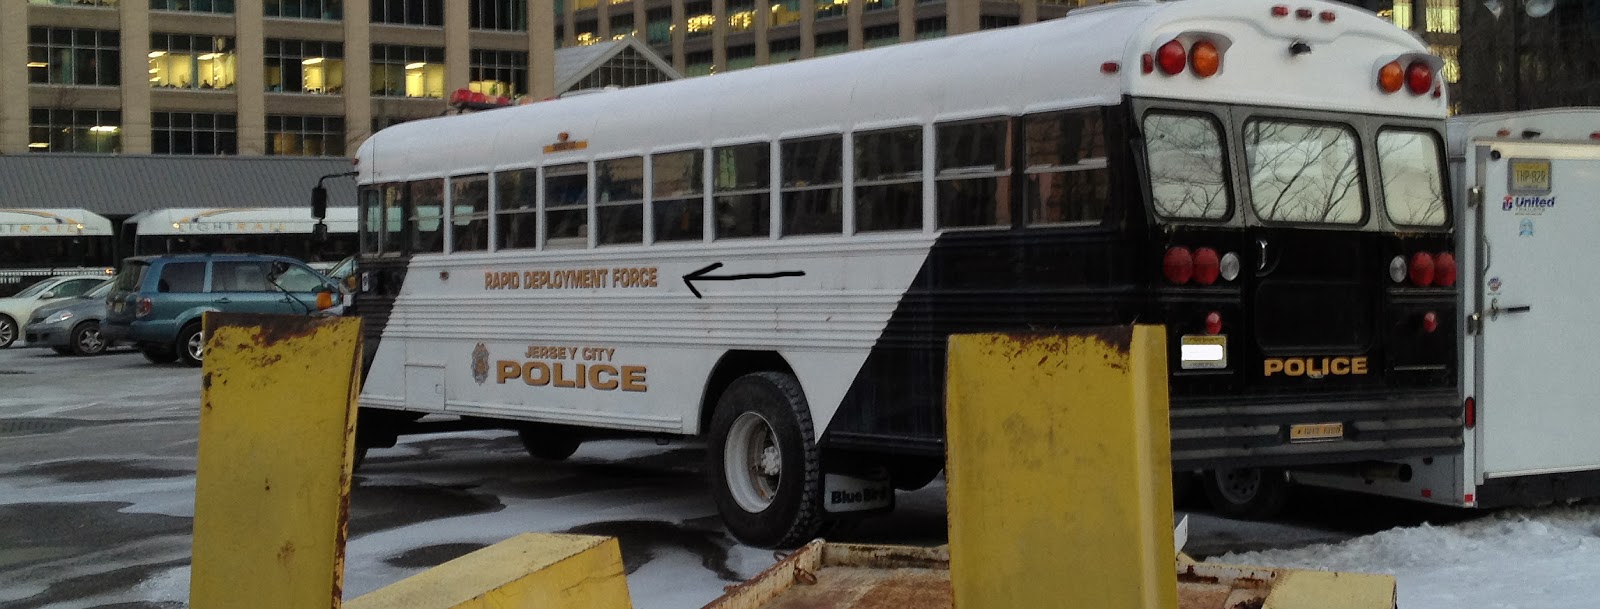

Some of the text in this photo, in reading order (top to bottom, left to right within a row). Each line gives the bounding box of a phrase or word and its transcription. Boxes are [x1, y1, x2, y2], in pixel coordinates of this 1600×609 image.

[1515, 196, 1555, 208] United
[484, 267, 658, 290] RAPID DEPLOYMENT FORCE
[524, 345, 615, 361] JERSEY CITY
[496, 360, 647, 392] POLICE
[1263, 356, 1368, 377] POLICE
